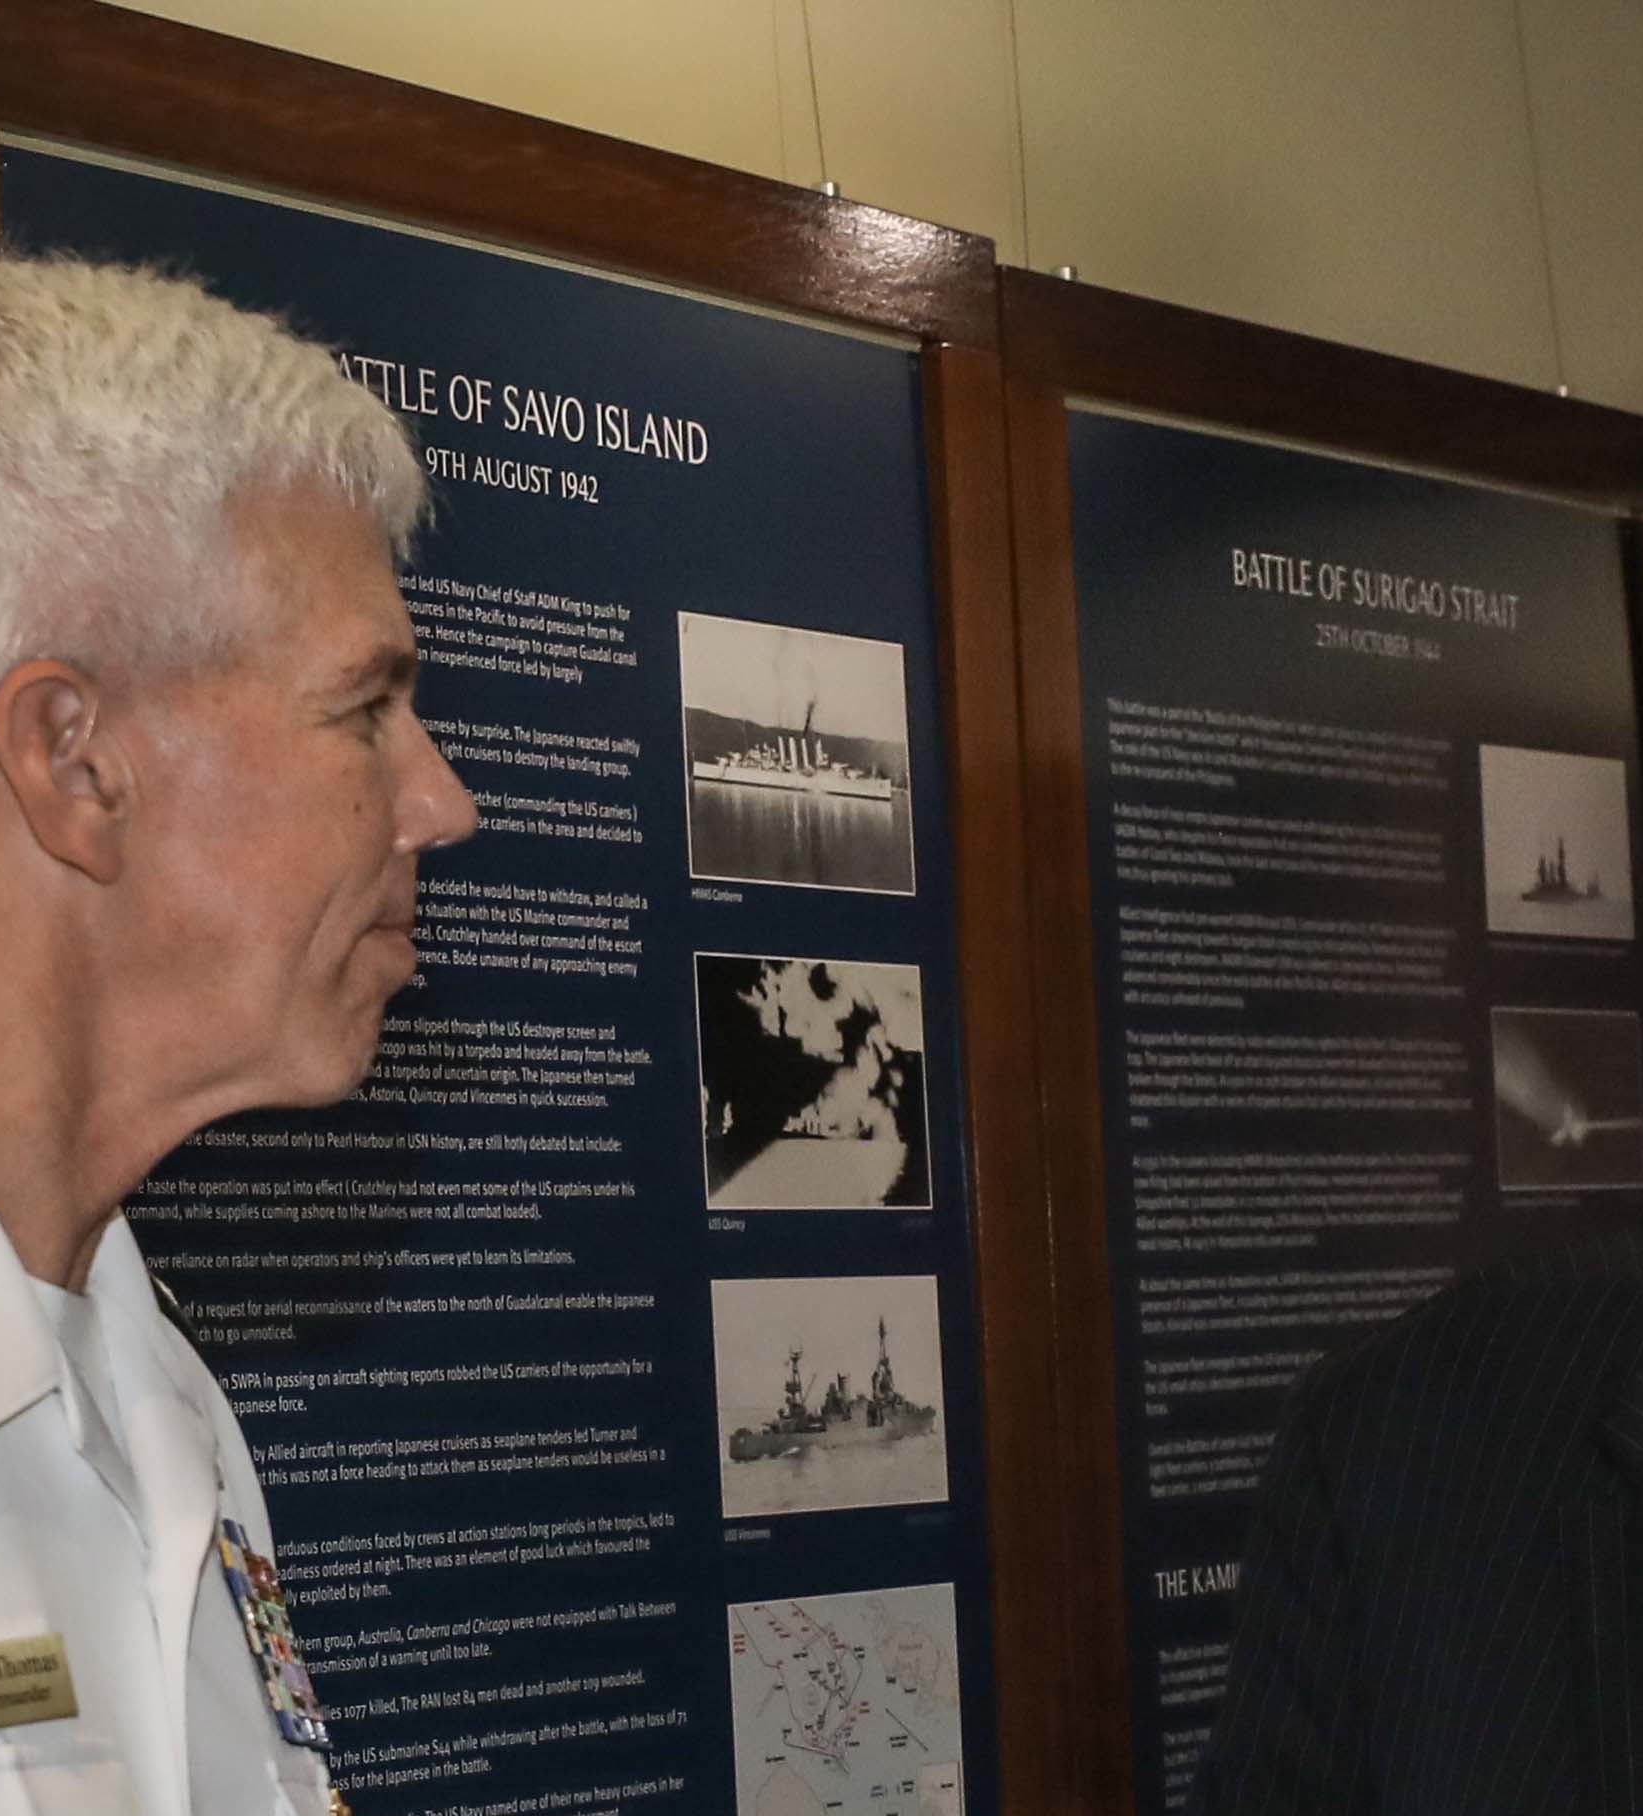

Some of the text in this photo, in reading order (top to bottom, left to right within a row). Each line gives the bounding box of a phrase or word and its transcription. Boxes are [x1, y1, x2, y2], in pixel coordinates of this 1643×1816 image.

[339, 352, 707, 465] ATTLE OF SAVO ISLAND
[426, 446, 598, 503] 9TH AUGUST 1942
[1233, 548, 1519, 630] BATTLE OF SURIGAO STRAIT
[464, 746, 501, 762] cruisers
[503, 749, 513, 764] to
[515, 749, 548, 770] destroy
[550, 753, 565, 770] the
[567, 755, 601, 776] landing
[603, 762, 631, 778] group.
[172, 1252, 213, 1269] reliance
[216, 1255, 229, 1268] on
[232, 1252, 259, 1268] radar
[261, 1252, 288, 1268] when
[291, 1253, 339, 1270] operators
[342, 1250, 360, 1267] and
[363, 1250, 392, 1269] ship's
[394, 1250, 430, 1266] officers
[432, 1253, 454, 1265] were
[456, 1251, 471, 1268] yet
[473, 1251, 483, 1265] to
[484, 1249, 508, 1265] learn
[510, 1248, 522, 1264] its
[524, 1249, 575, 1265] limitations.
[1155, 1563, 1240, 1599] THE KAMI
